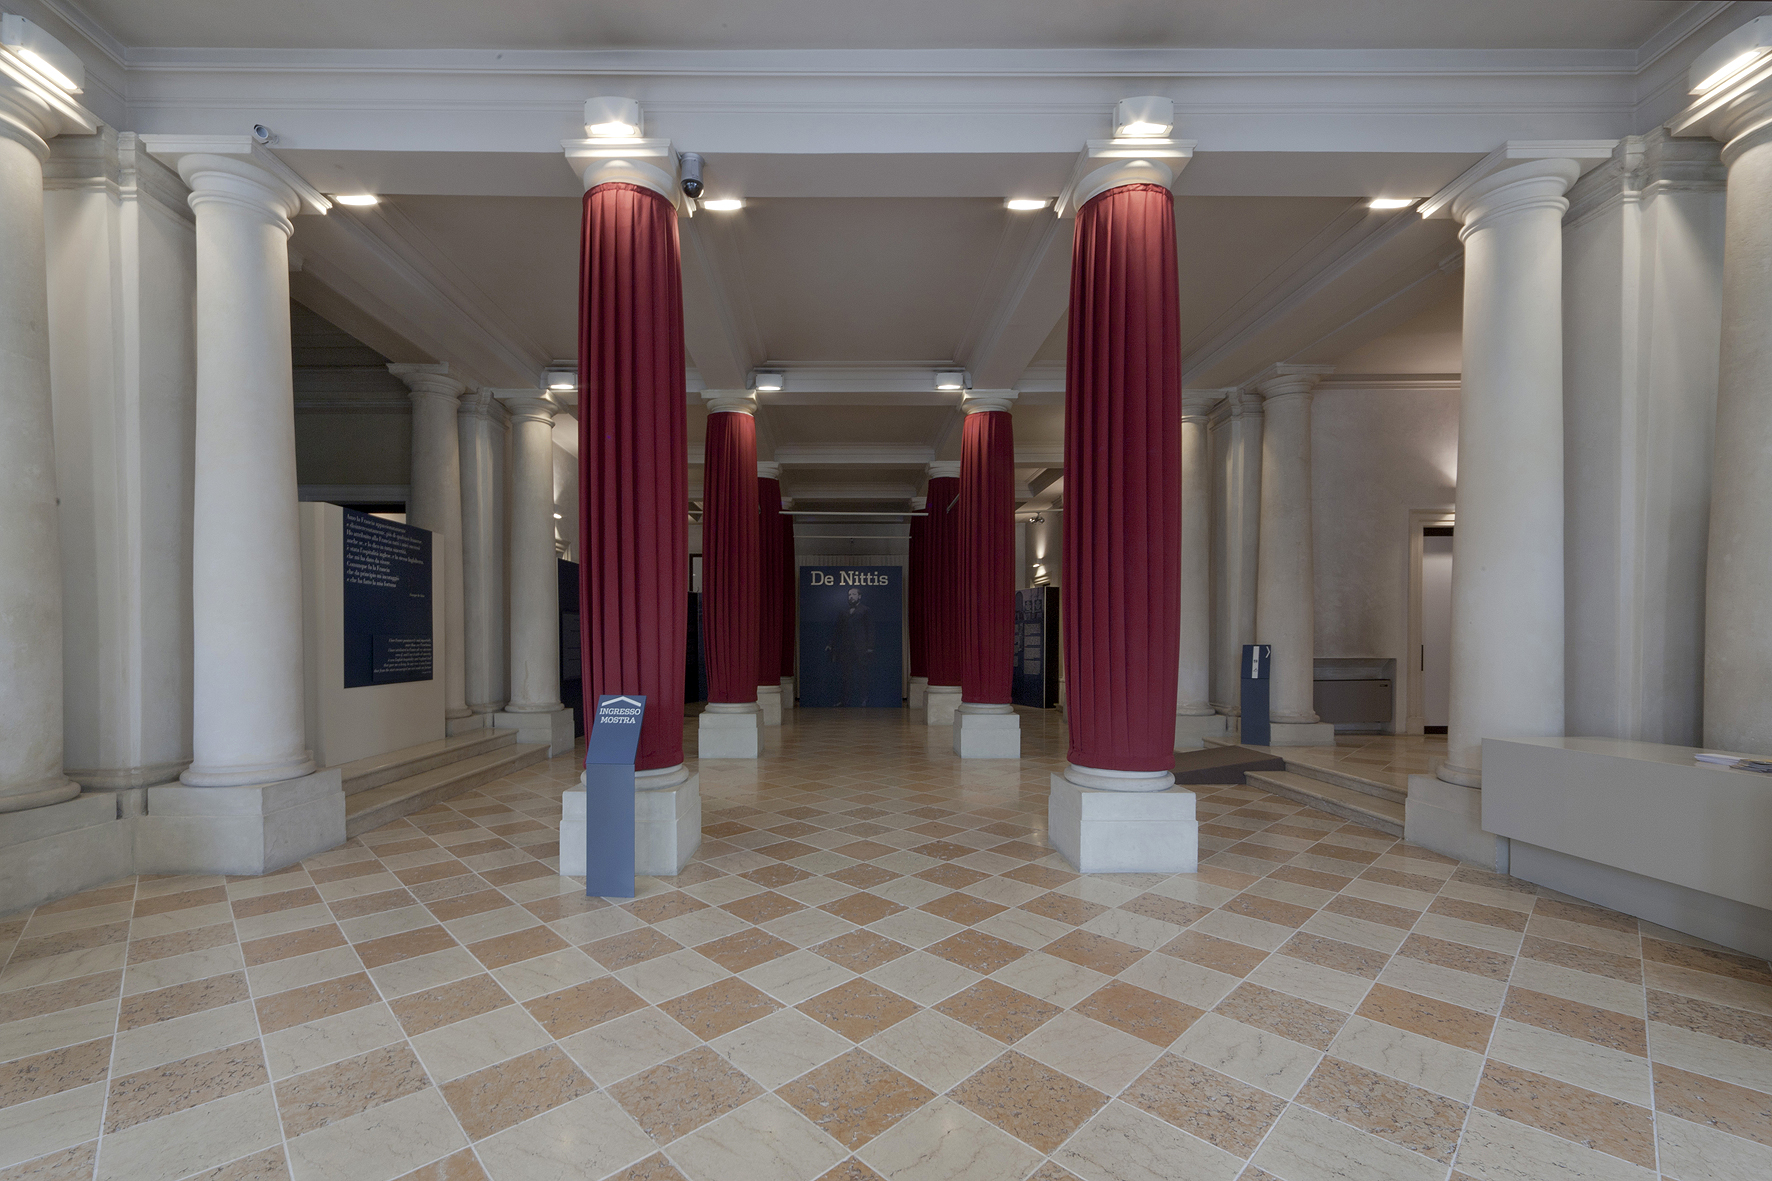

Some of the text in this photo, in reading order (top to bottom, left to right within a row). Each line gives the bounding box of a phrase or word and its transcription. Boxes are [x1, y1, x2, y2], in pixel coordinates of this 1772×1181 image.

[811, 571, 889, 586] De Nittis
[599, 707, 641, 715] INGRESSO
[600, 716, 636, 724] MOSTRA
